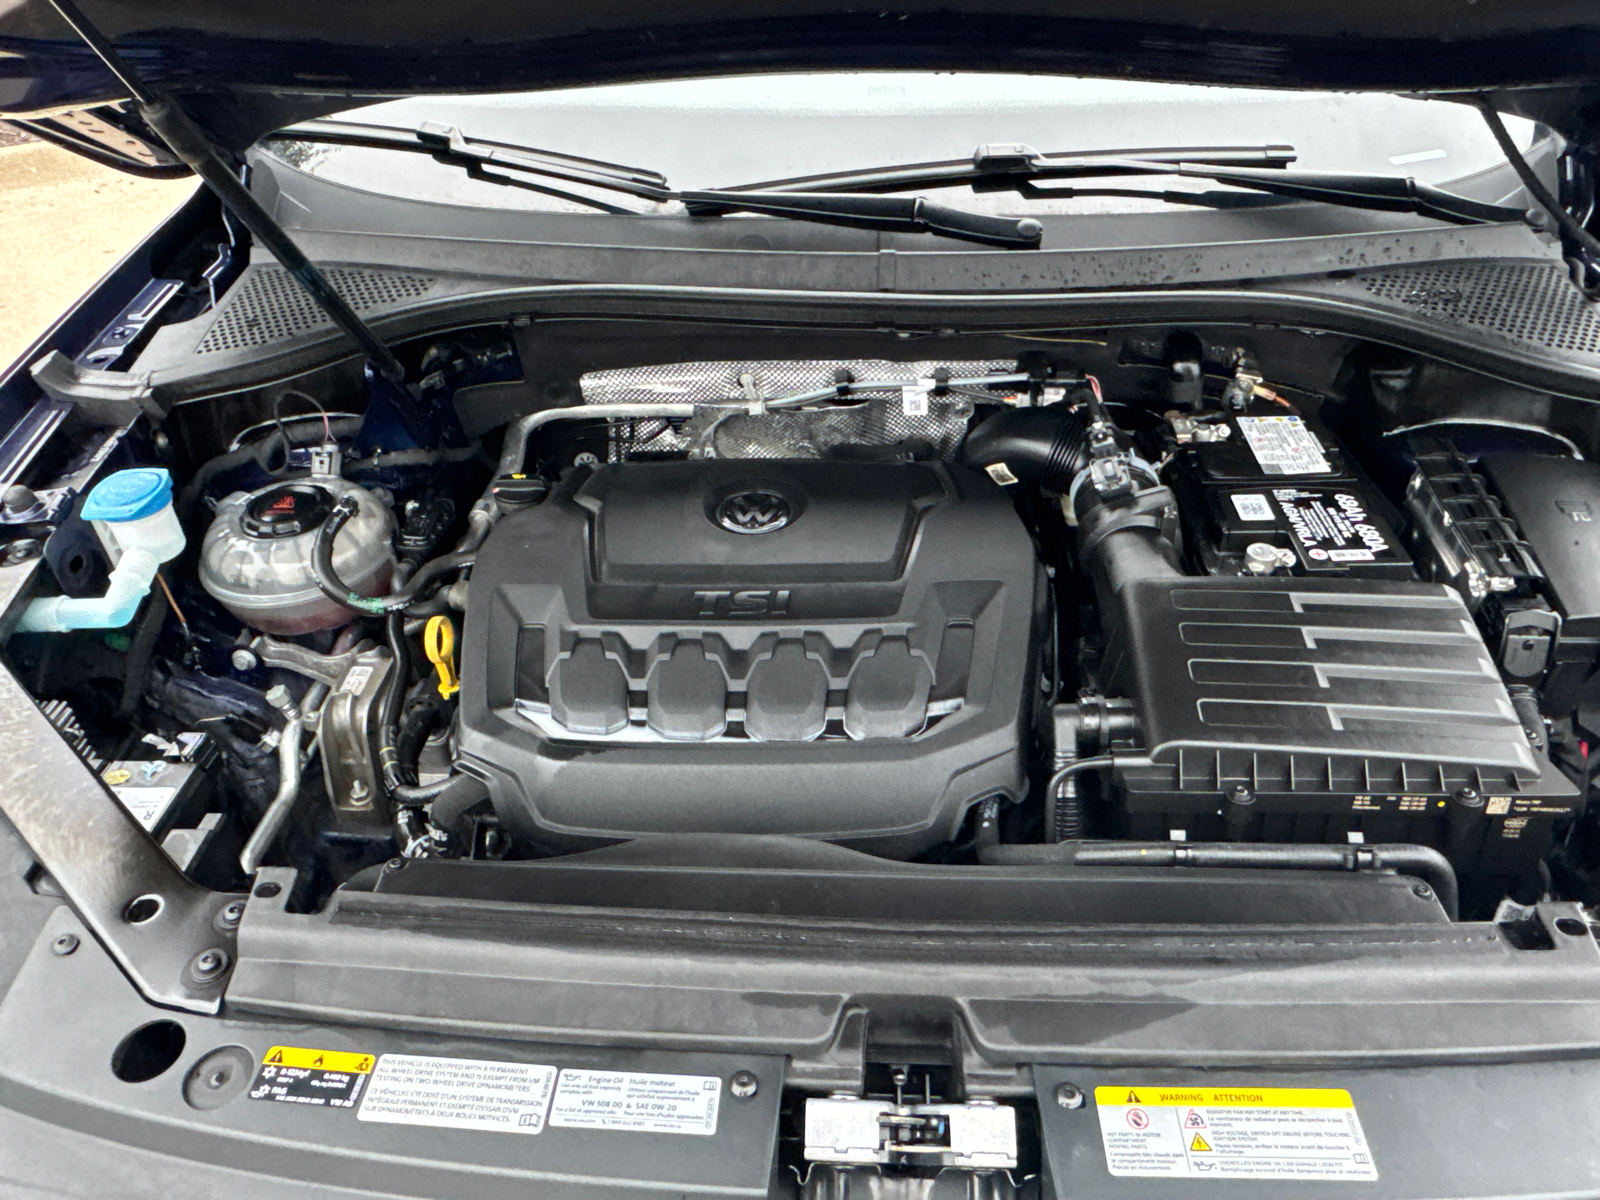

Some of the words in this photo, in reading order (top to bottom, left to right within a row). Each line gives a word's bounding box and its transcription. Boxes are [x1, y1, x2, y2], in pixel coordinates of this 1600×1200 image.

[694, 590, 790, 615] TSI
[379, 1066, 413, 1075] ALL-WHEEL
[483, 1074, 508, 1082] EXEMPT
[431, 1062, 464, 1070] EQUIPPED
[489, 1066, 529, 1074] PERMANENT
[376, 1074, 402, 1082] TESTING
[415, 1077, 455, 1087] TWO-WHEEL
[456, 1080, 475, 1088] DRIVE
[588, 1076, 612, 1084] Engine
[1159, 1093, 1204, 1102] WARNING
[1214, 1094, 1263, 1102] ATTENTION
[635, 1102, 649, 1110] SAE
